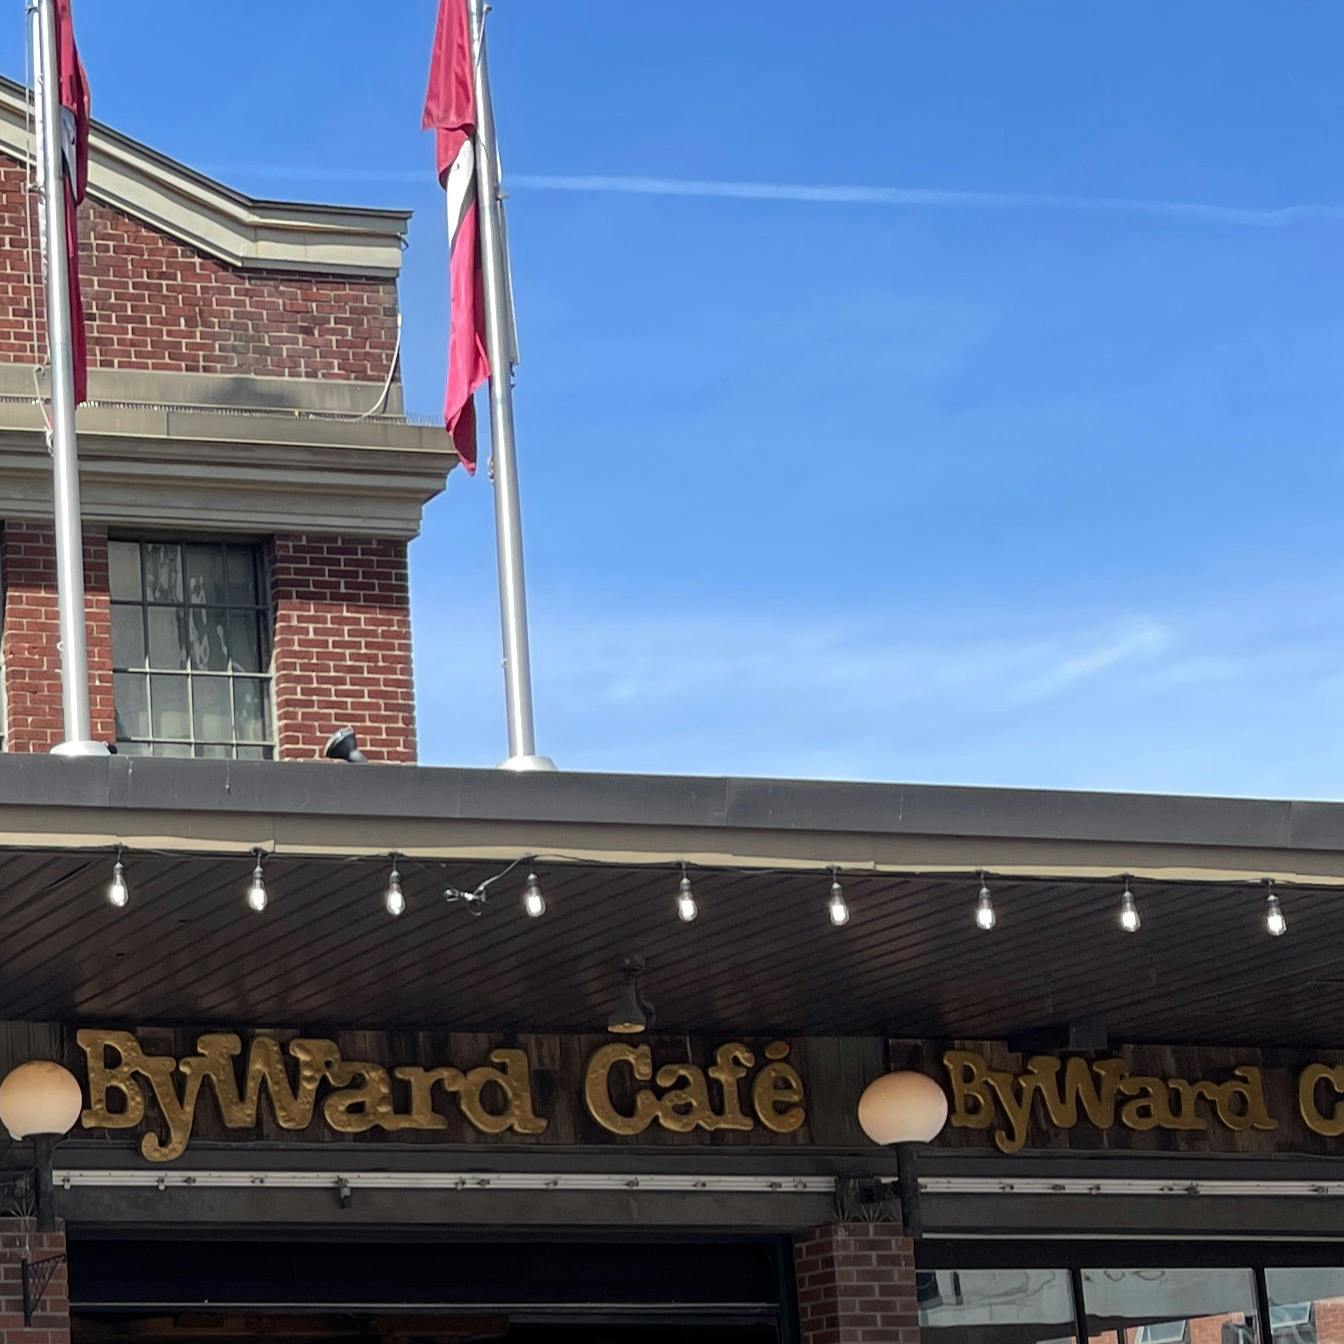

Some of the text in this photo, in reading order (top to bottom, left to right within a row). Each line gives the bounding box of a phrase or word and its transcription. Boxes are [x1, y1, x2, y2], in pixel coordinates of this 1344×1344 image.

[76, 1028, 807, 1162] ByWard Café
[942, 1050, 1279, 1154] ByWard
